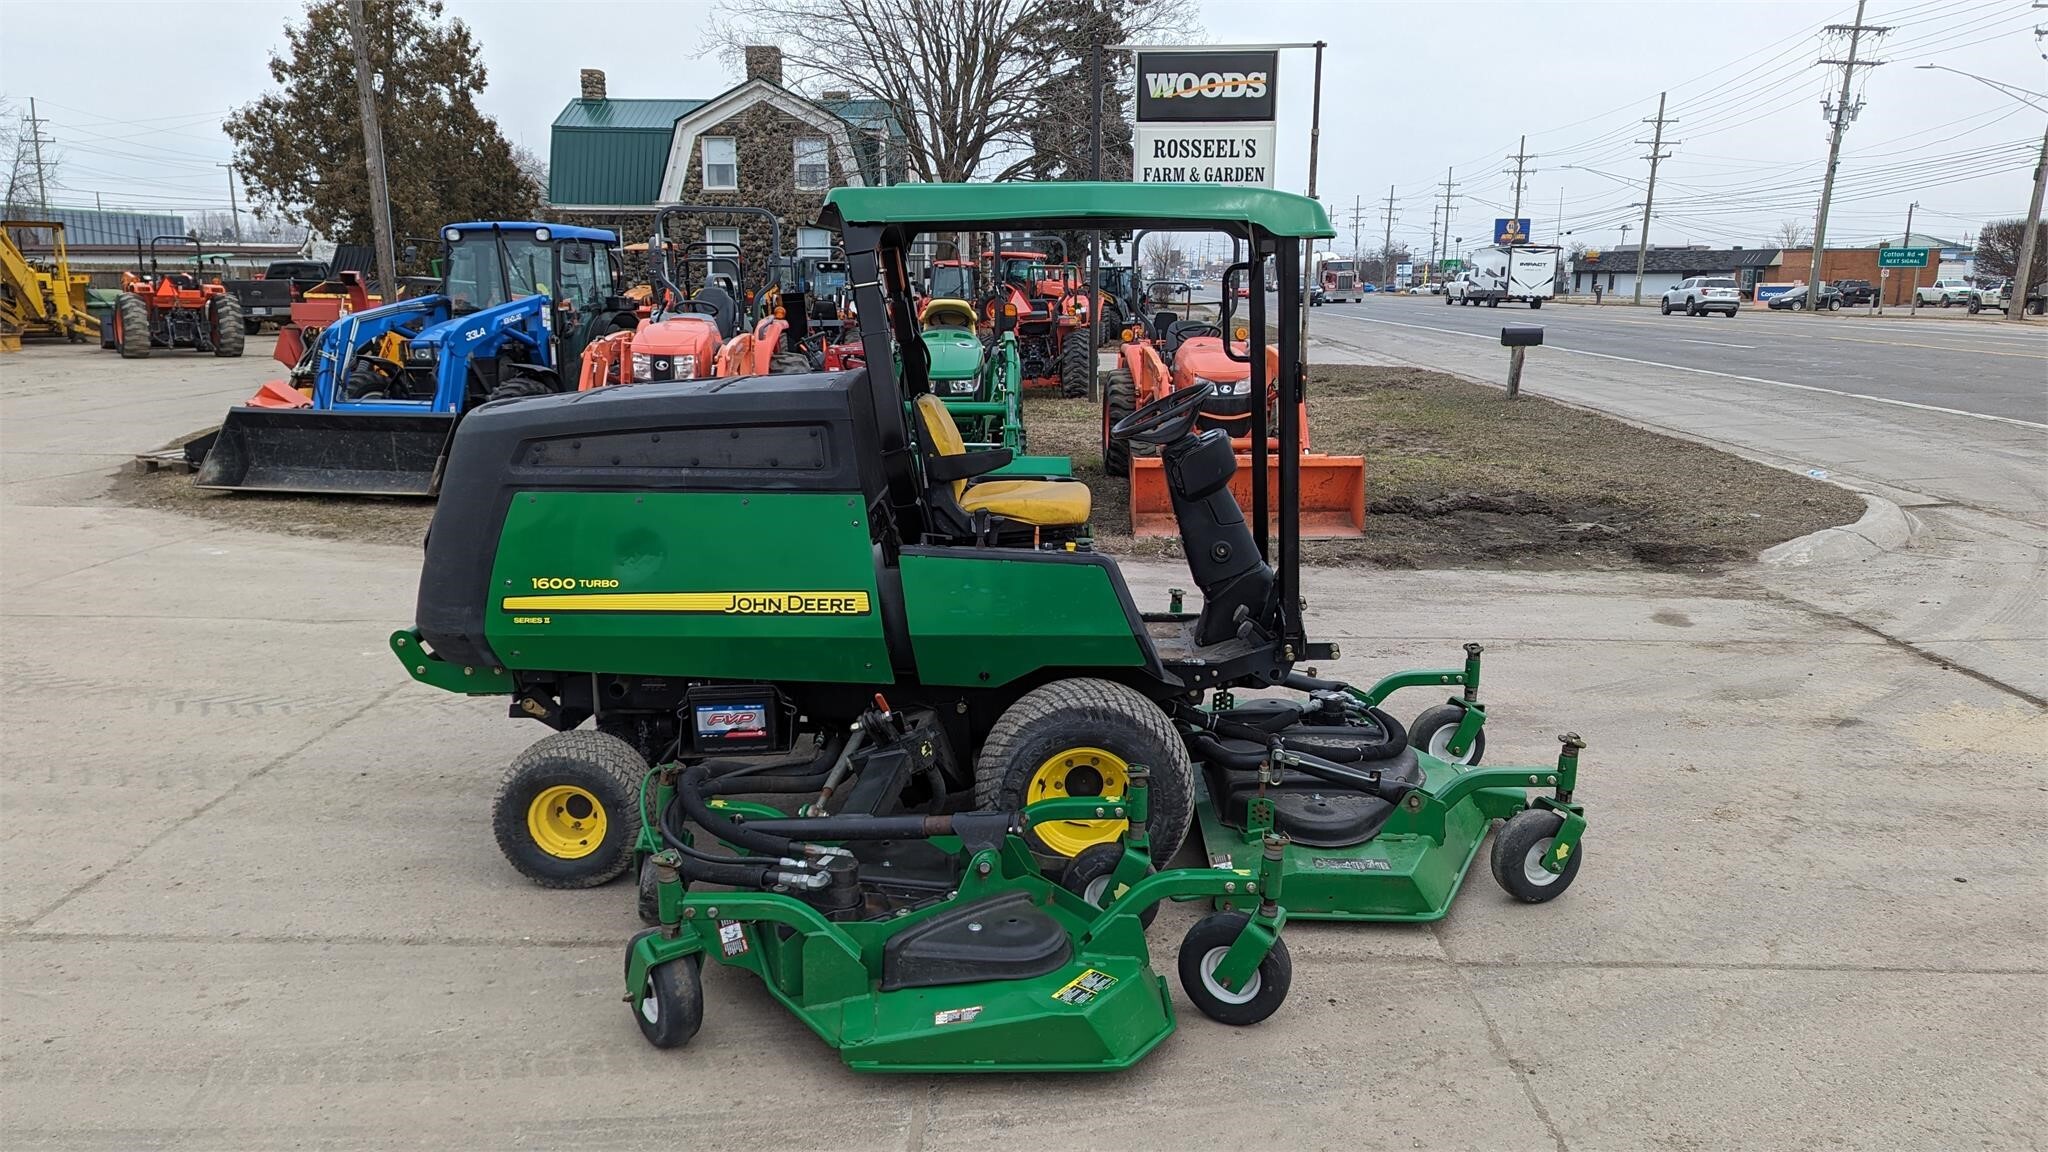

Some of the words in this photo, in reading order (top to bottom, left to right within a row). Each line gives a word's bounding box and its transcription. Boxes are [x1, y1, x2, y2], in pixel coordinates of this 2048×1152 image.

[1145, 72, 1267, 98] WOODS
[1153, 138, 1257, 158] ROSSEEL'S
[1143, 167, 1185, 182] FARM
[1189, 166, 1200, 182] &
[1204, 166, 1265, 182] GARDEN
[465, 327, 486, 342] 33LA
[531, 577, 576, 589] 1600
[578, 579, 619, 588] TURBO
[725, 595, 782, 611] JOHN
[787, 595, 857, 611] DEERE
[707, 712, 756, 726] FVP
